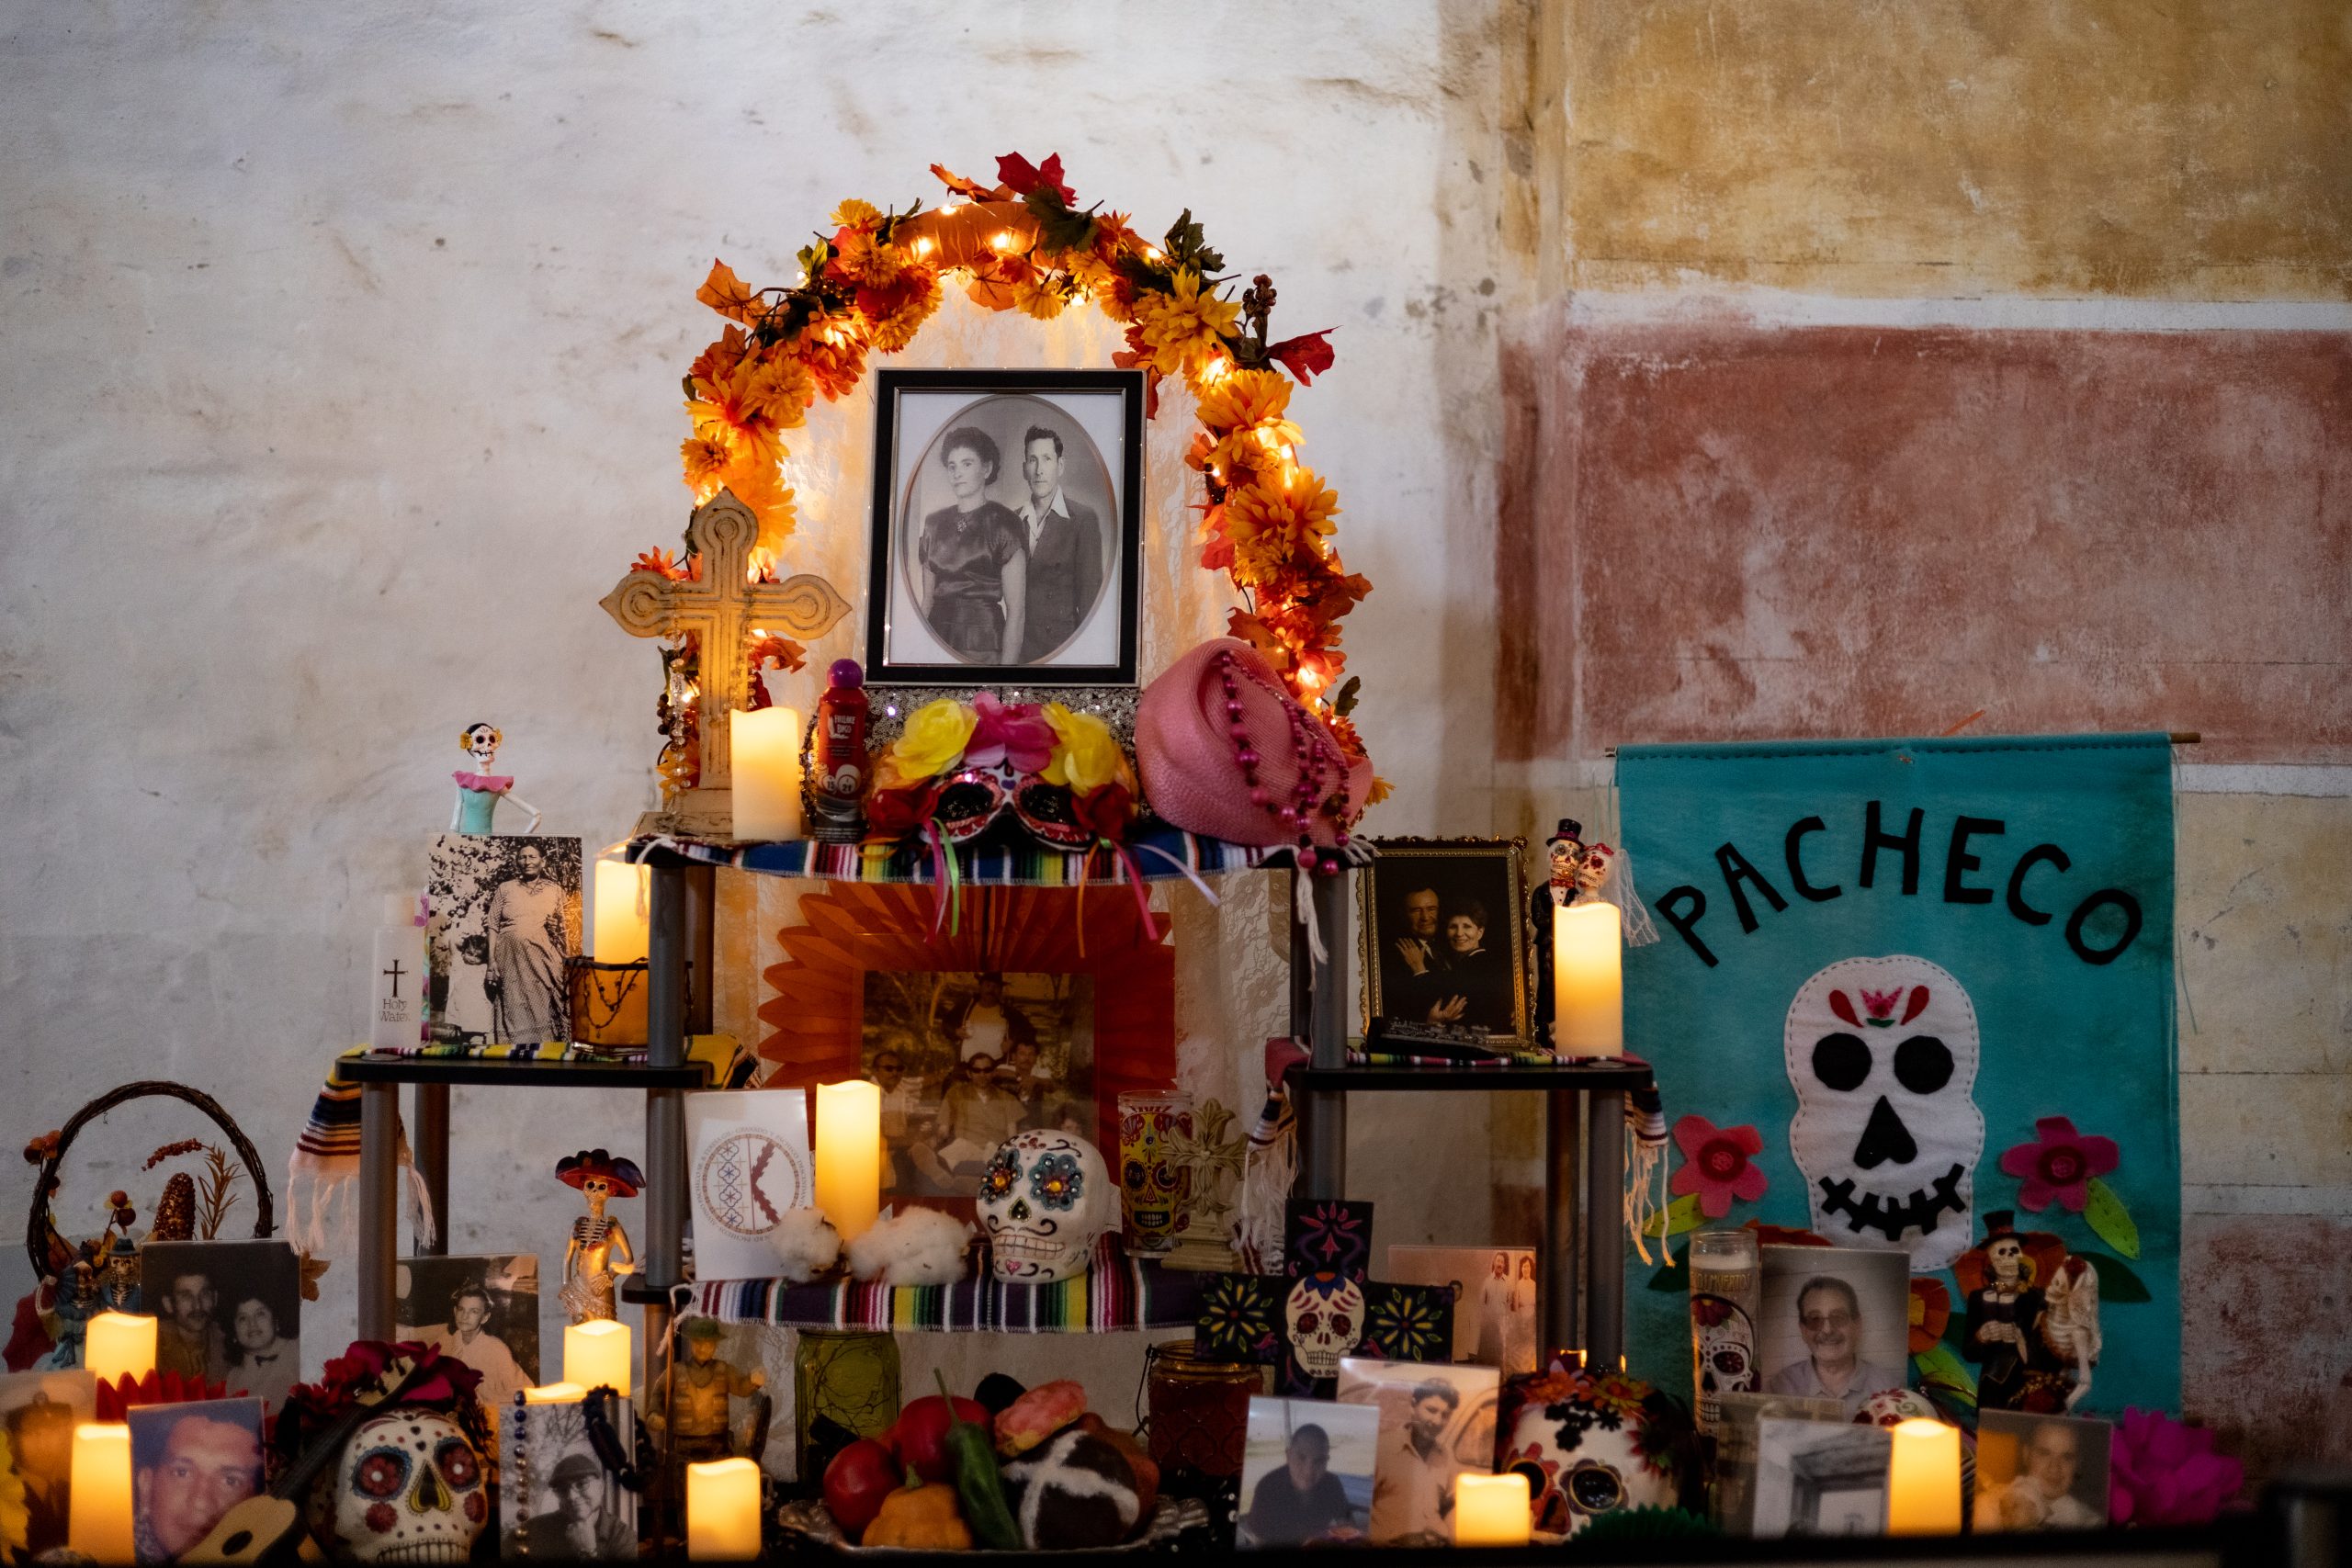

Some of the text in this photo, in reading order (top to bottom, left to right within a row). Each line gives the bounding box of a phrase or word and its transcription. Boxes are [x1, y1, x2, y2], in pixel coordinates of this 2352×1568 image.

[842, 784, 852, 792] 21
[1655, 800, 2143, 967] PACHECO
[382, 998, 407, 1011] Holy
[379, 1010, 411, 1022] Water
